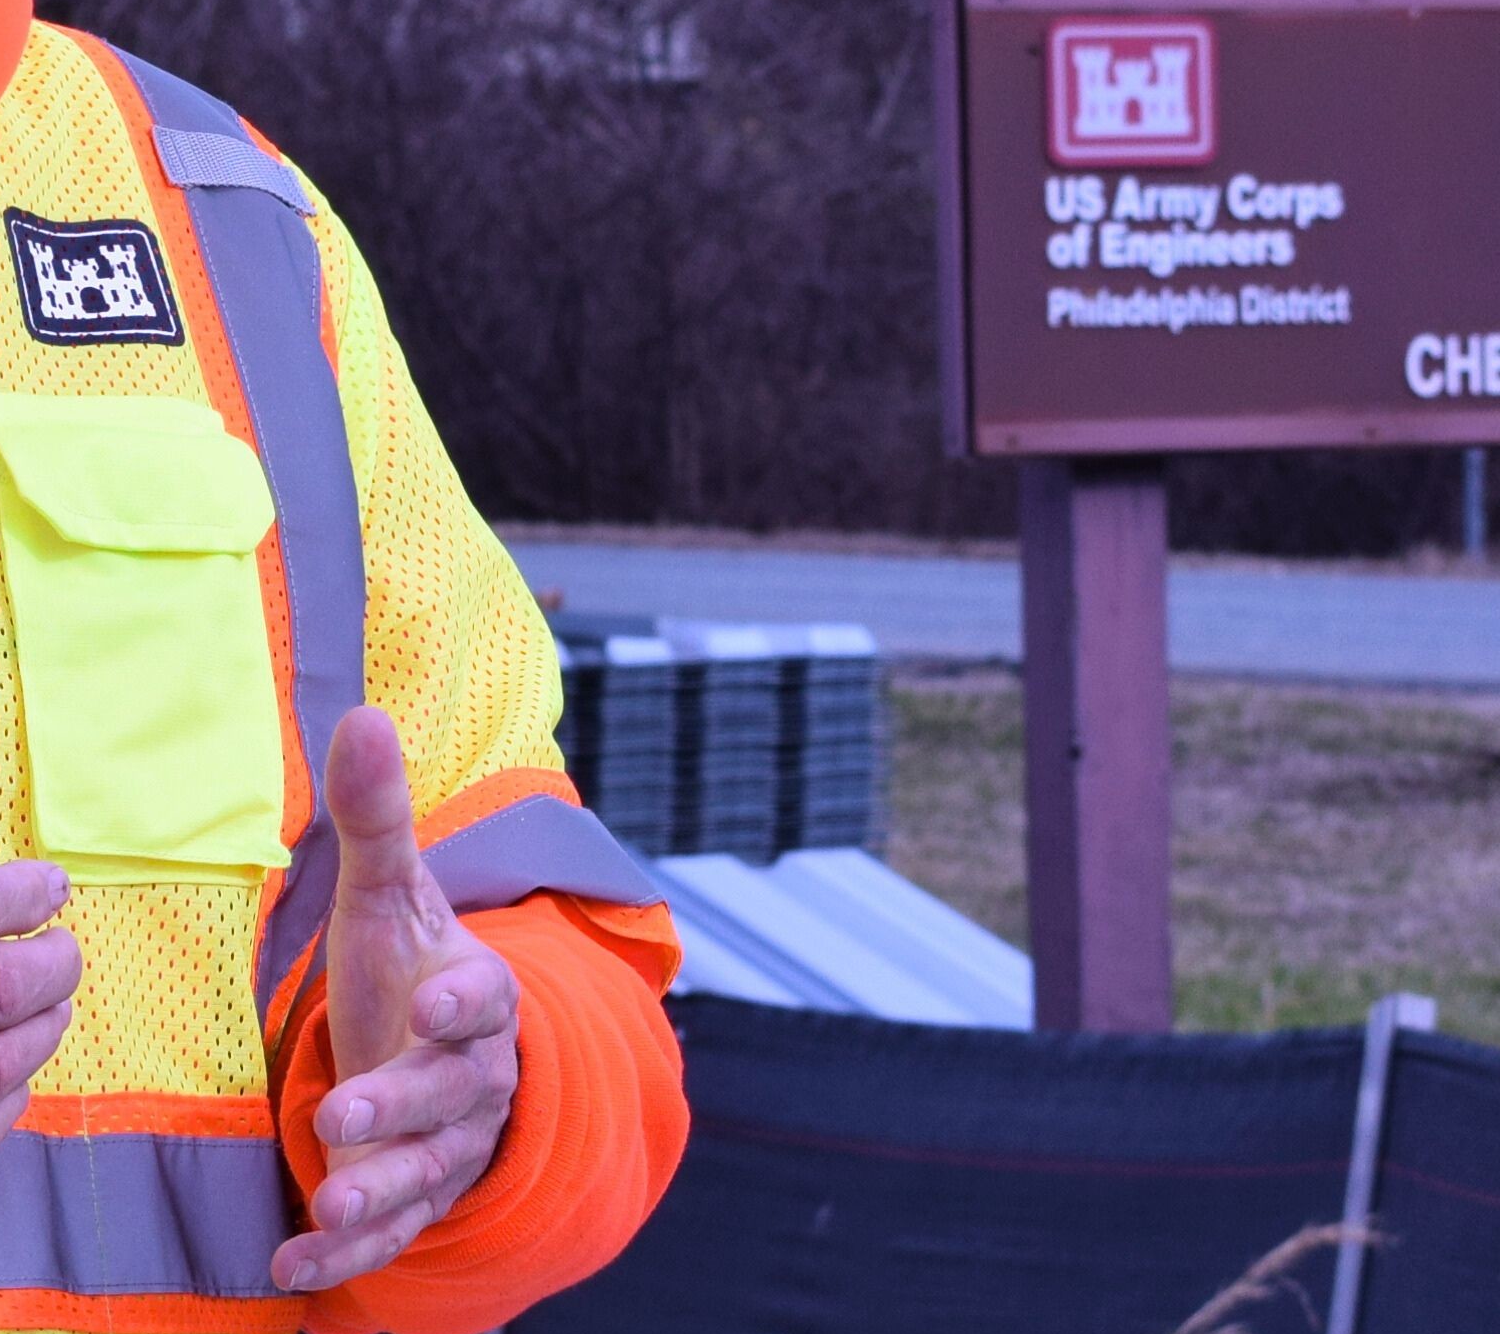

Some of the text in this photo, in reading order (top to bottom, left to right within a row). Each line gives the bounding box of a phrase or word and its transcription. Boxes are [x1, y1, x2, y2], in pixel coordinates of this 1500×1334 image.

[1044, 173, 1345, 229] US Army Corps
[1047, 222, 1296, 278] of Engineers
[1047, 283, 1351, 335] Philadelphia District
